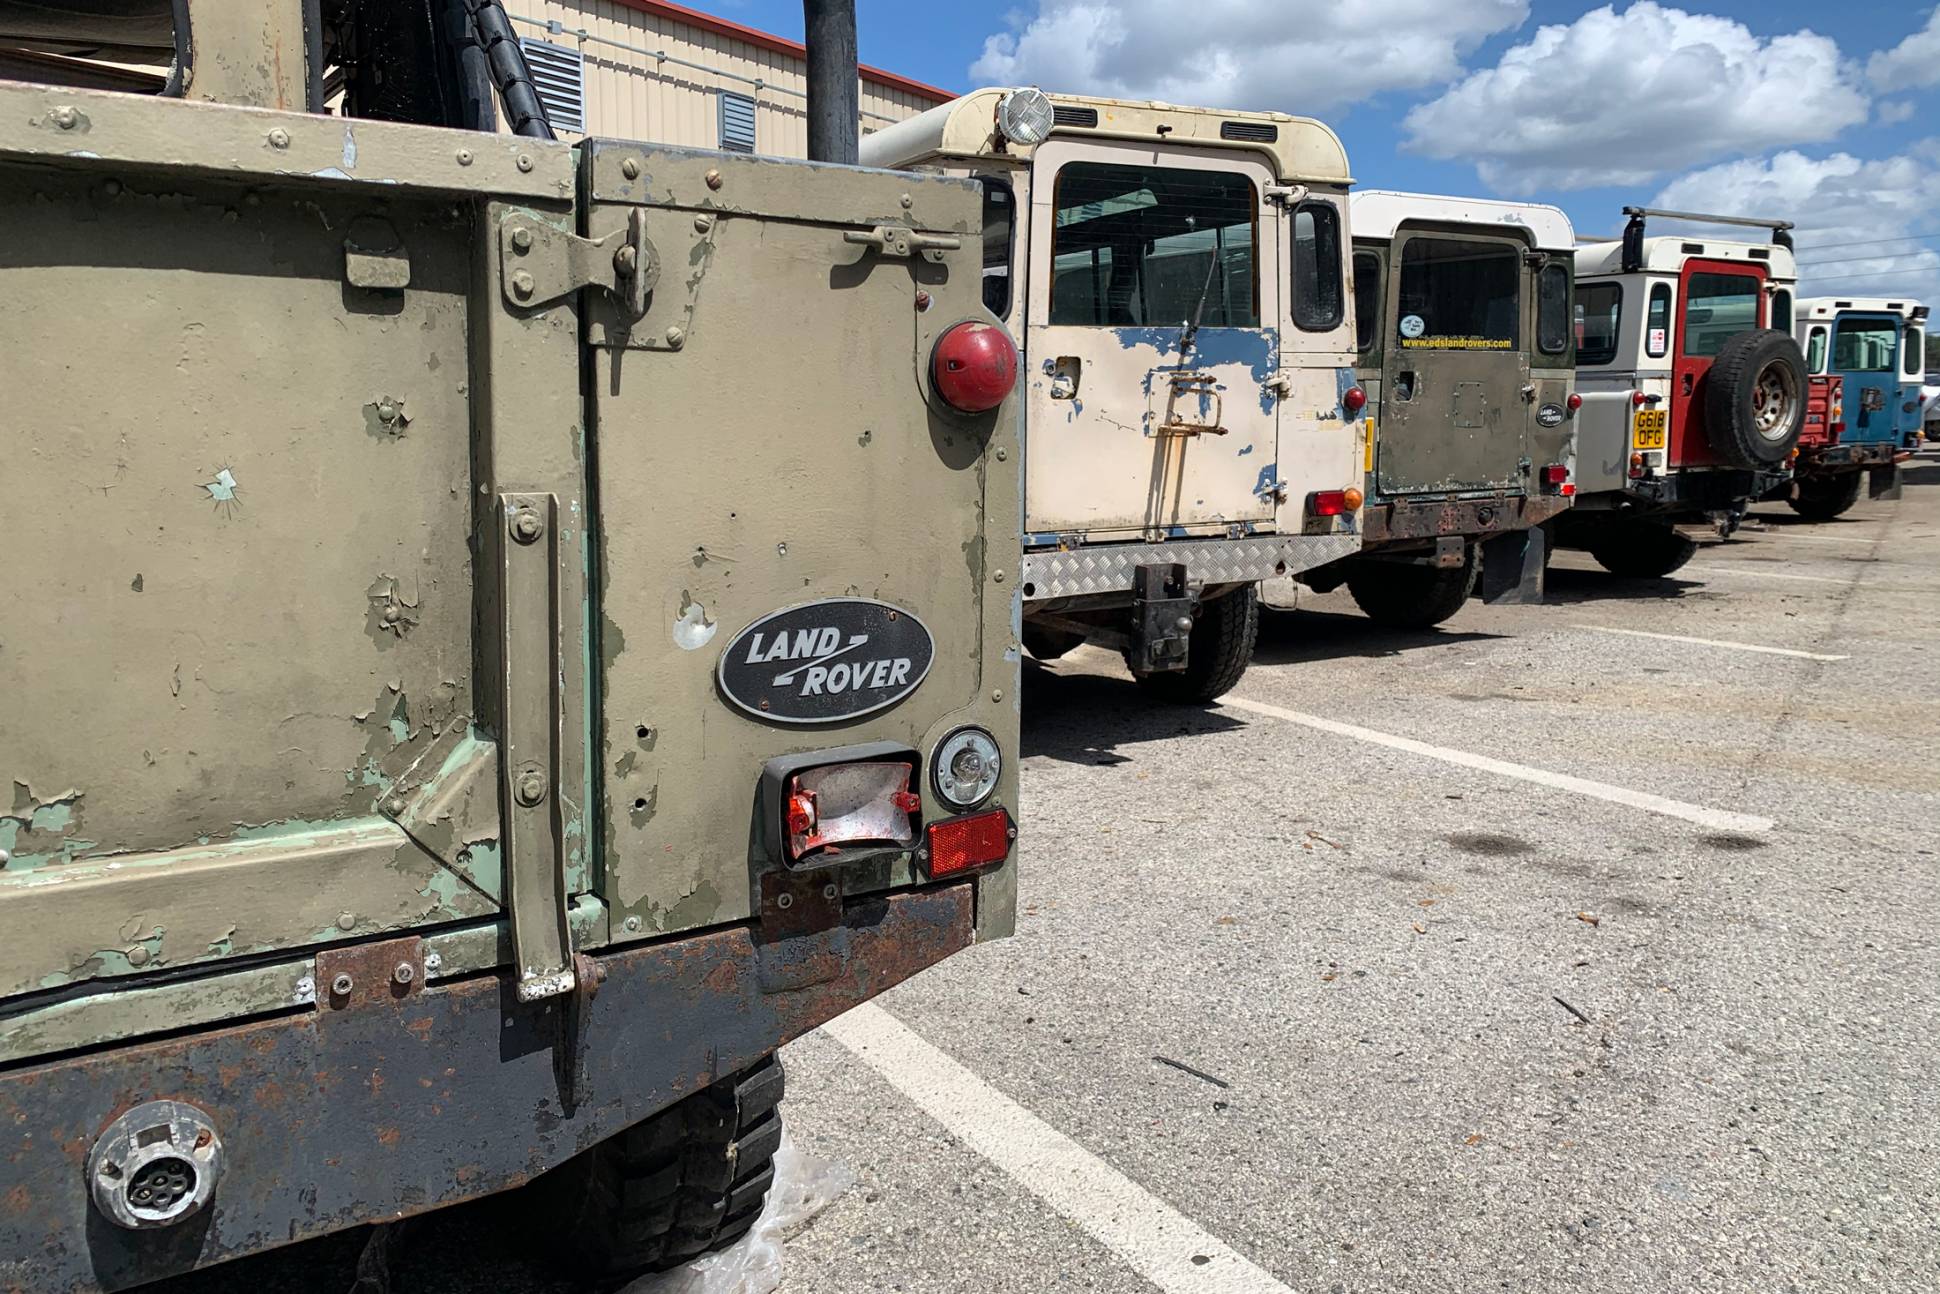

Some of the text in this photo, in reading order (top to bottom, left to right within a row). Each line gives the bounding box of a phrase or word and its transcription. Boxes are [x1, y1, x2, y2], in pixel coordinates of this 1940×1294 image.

[1402, 337, 1512, 349] www.edslandrovers.com
[1638, 412, 1665, 427] G618
[1639, 430, 1662, 445] OFG
[744, 626, 841, 665] LAND
[799, 657, 912, 697] ROVER
